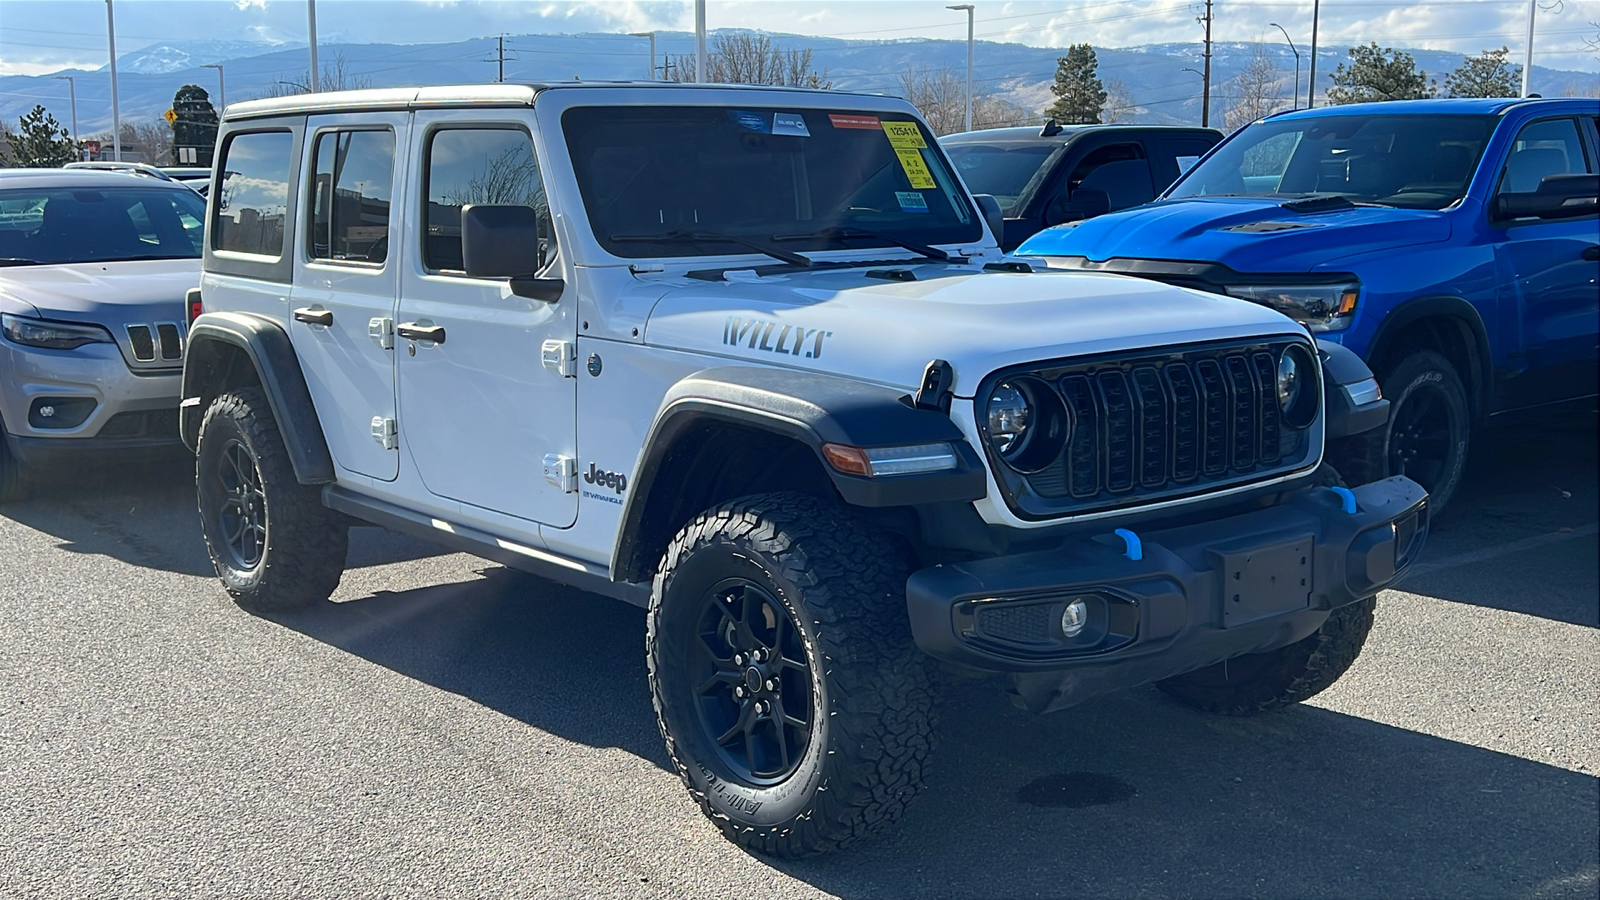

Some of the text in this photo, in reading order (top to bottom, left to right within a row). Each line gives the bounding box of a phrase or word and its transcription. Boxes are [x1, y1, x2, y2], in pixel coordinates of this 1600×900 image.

[890, 126, 919, 136] 125414
[723, 316, 833, 359] WILLYS
[583, 461, 627, 495] Jeep
[589, 491, 624, 506] WRANGLE
